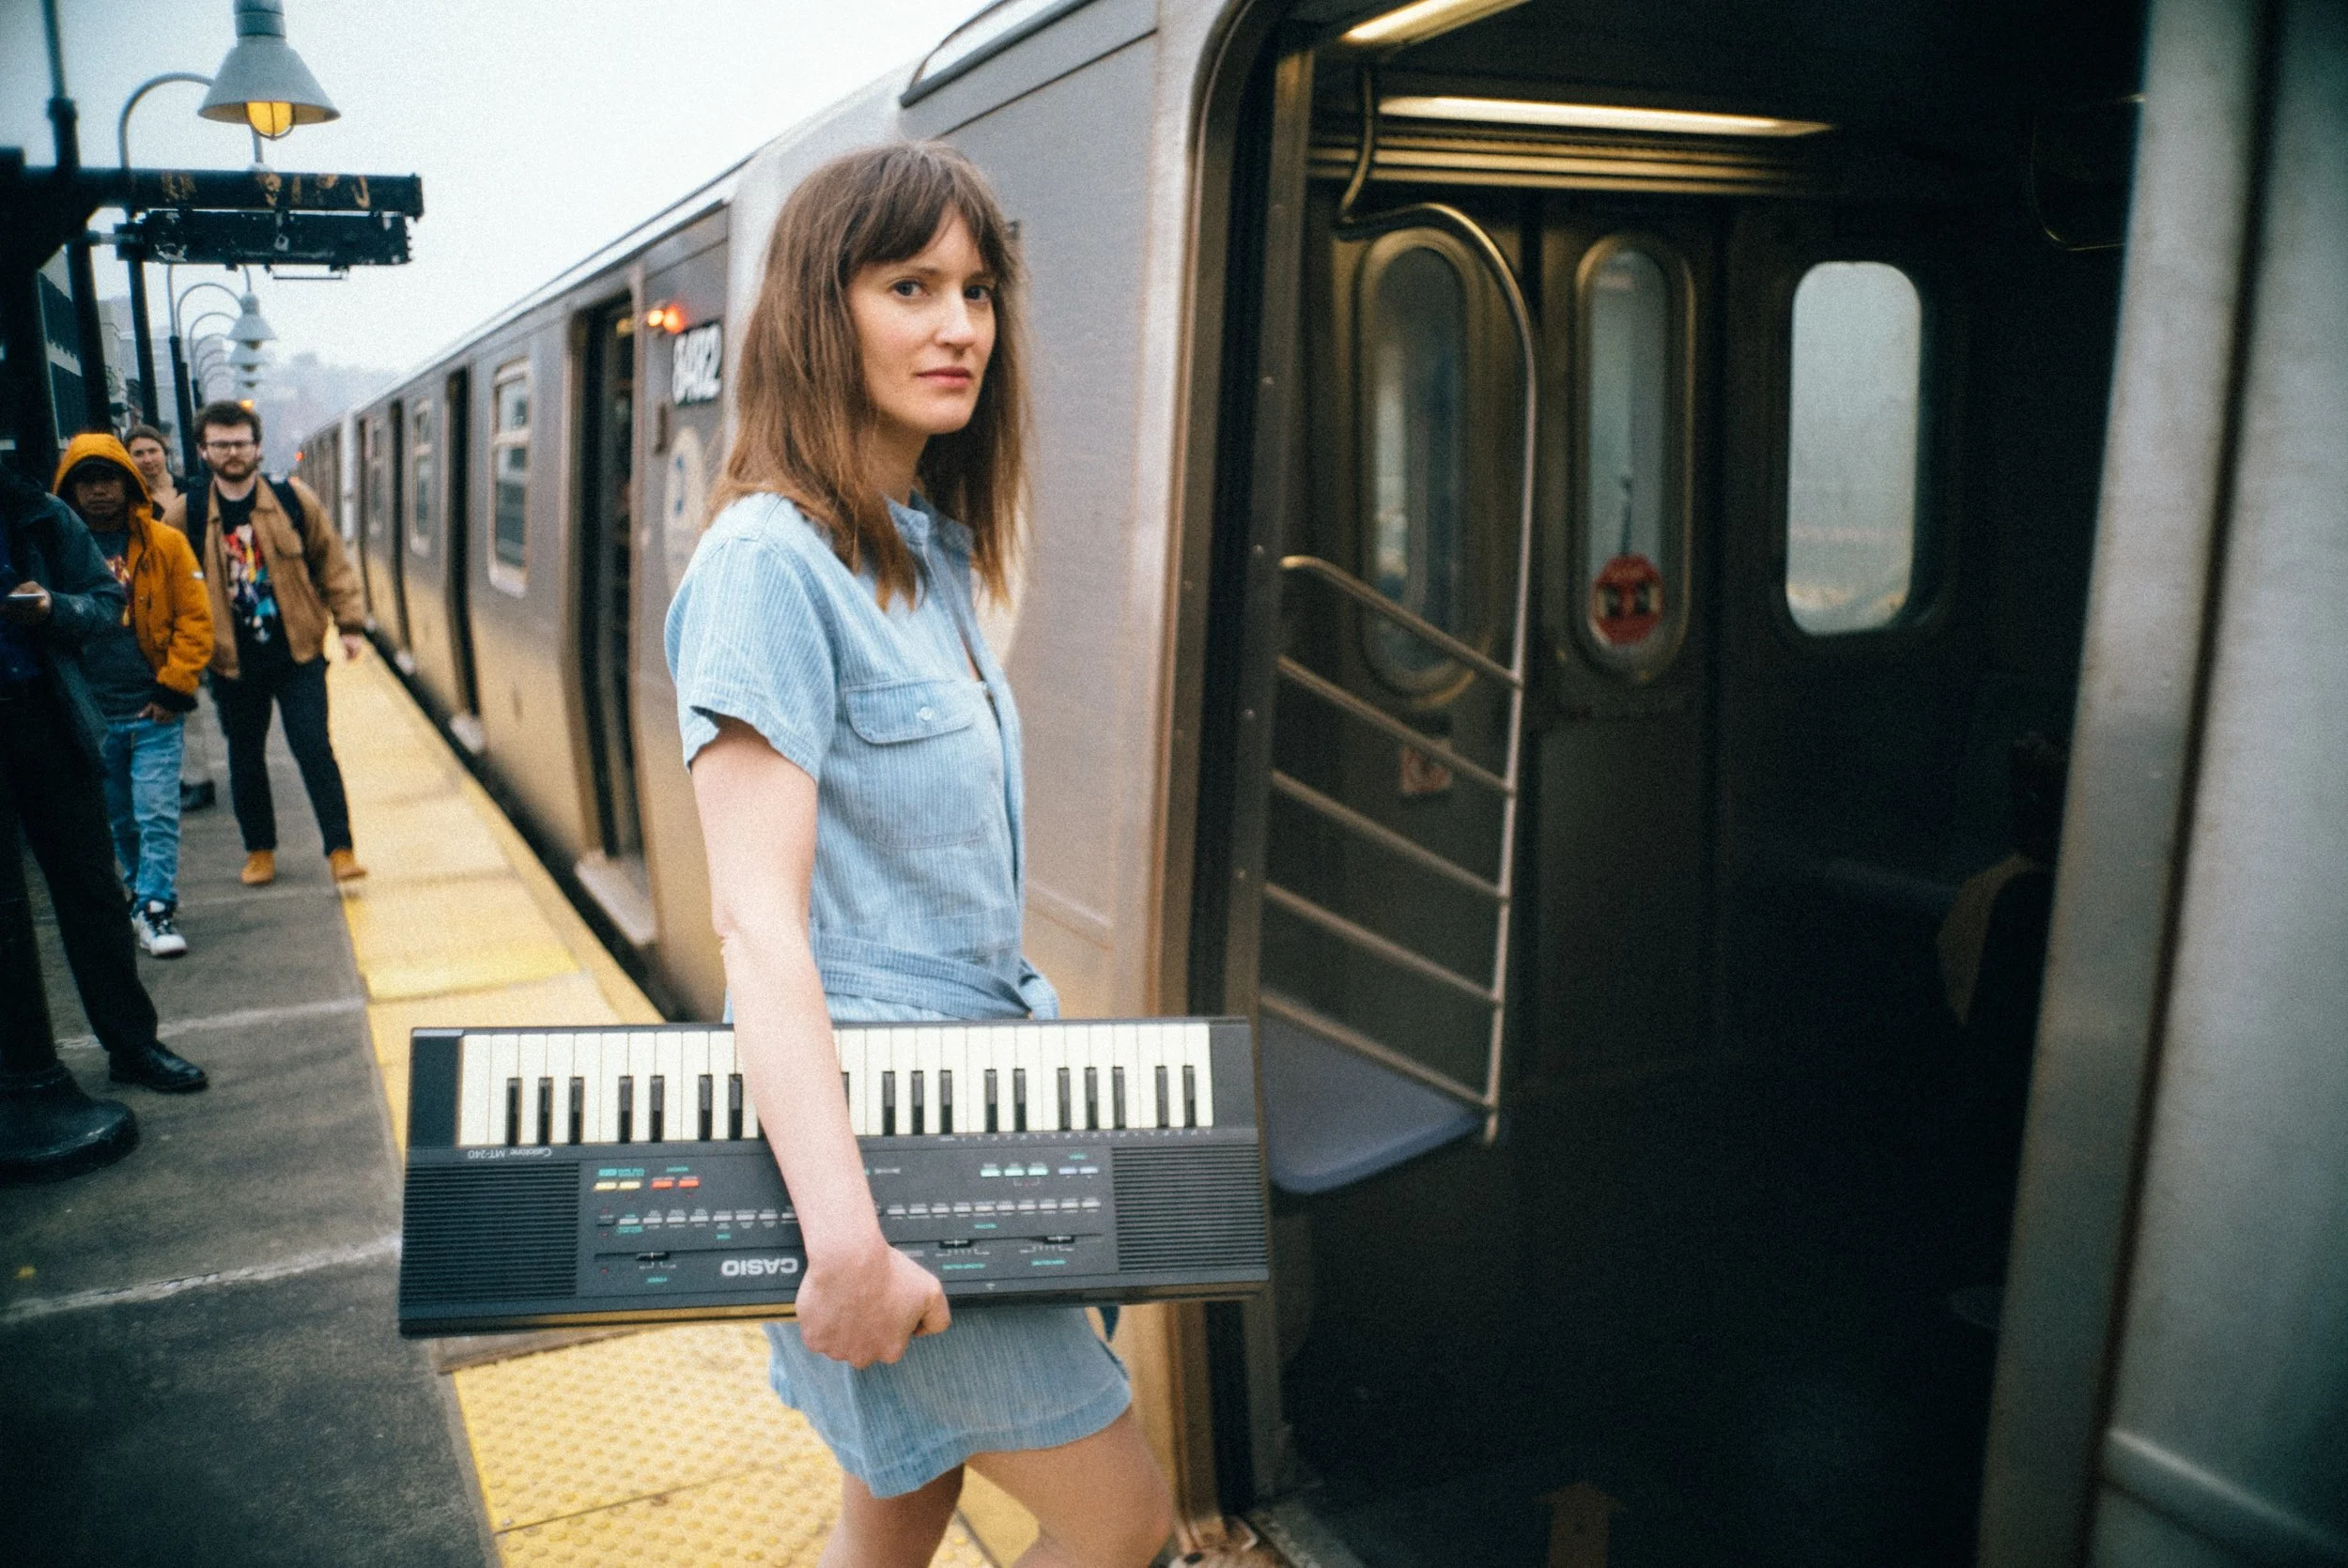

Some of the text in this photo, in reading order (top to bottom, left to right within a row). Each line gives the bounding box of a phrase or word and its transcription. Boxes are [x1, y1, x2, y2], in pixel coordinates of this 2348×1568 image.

[468, 1146, 552, 1160] Casiotone MT-240
[721, 1258, 798, 1277] CASIO
